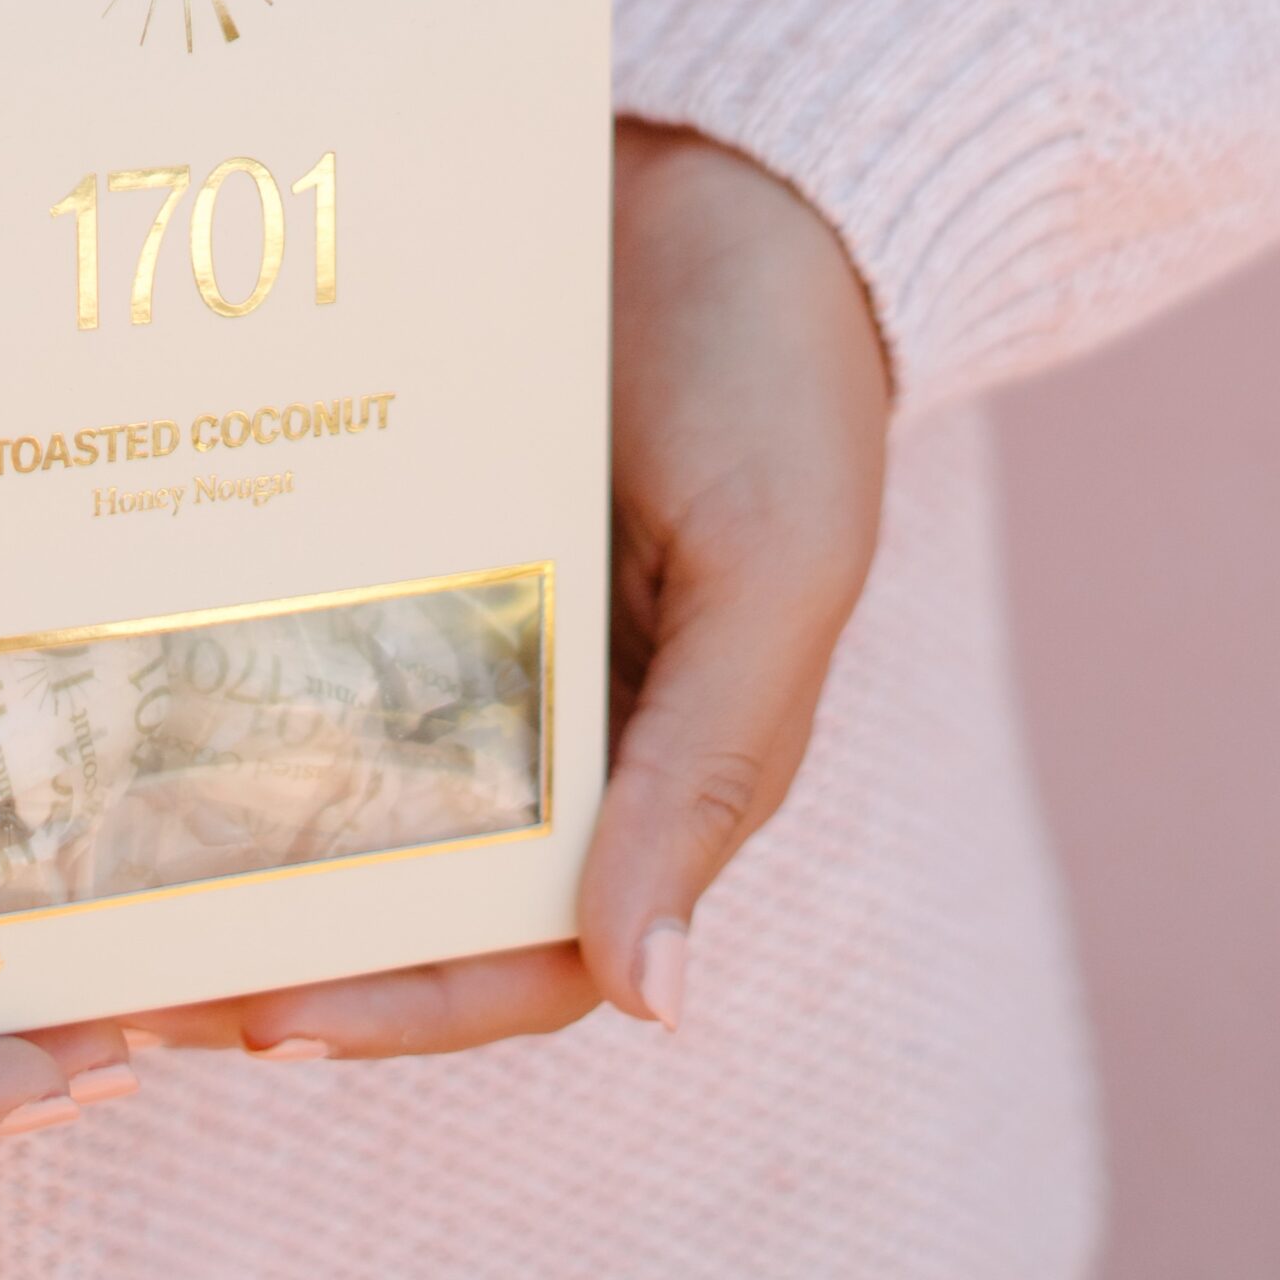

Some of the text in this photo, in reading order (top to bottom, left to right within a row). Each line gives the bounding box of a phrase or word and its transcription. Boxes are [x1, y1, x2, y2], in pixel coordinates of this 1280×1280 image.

[48, 150, 338, 331] 1701
[191, 391, 396, 453] COCONUT
[91, 469, 296, 518] Honey Nougat
